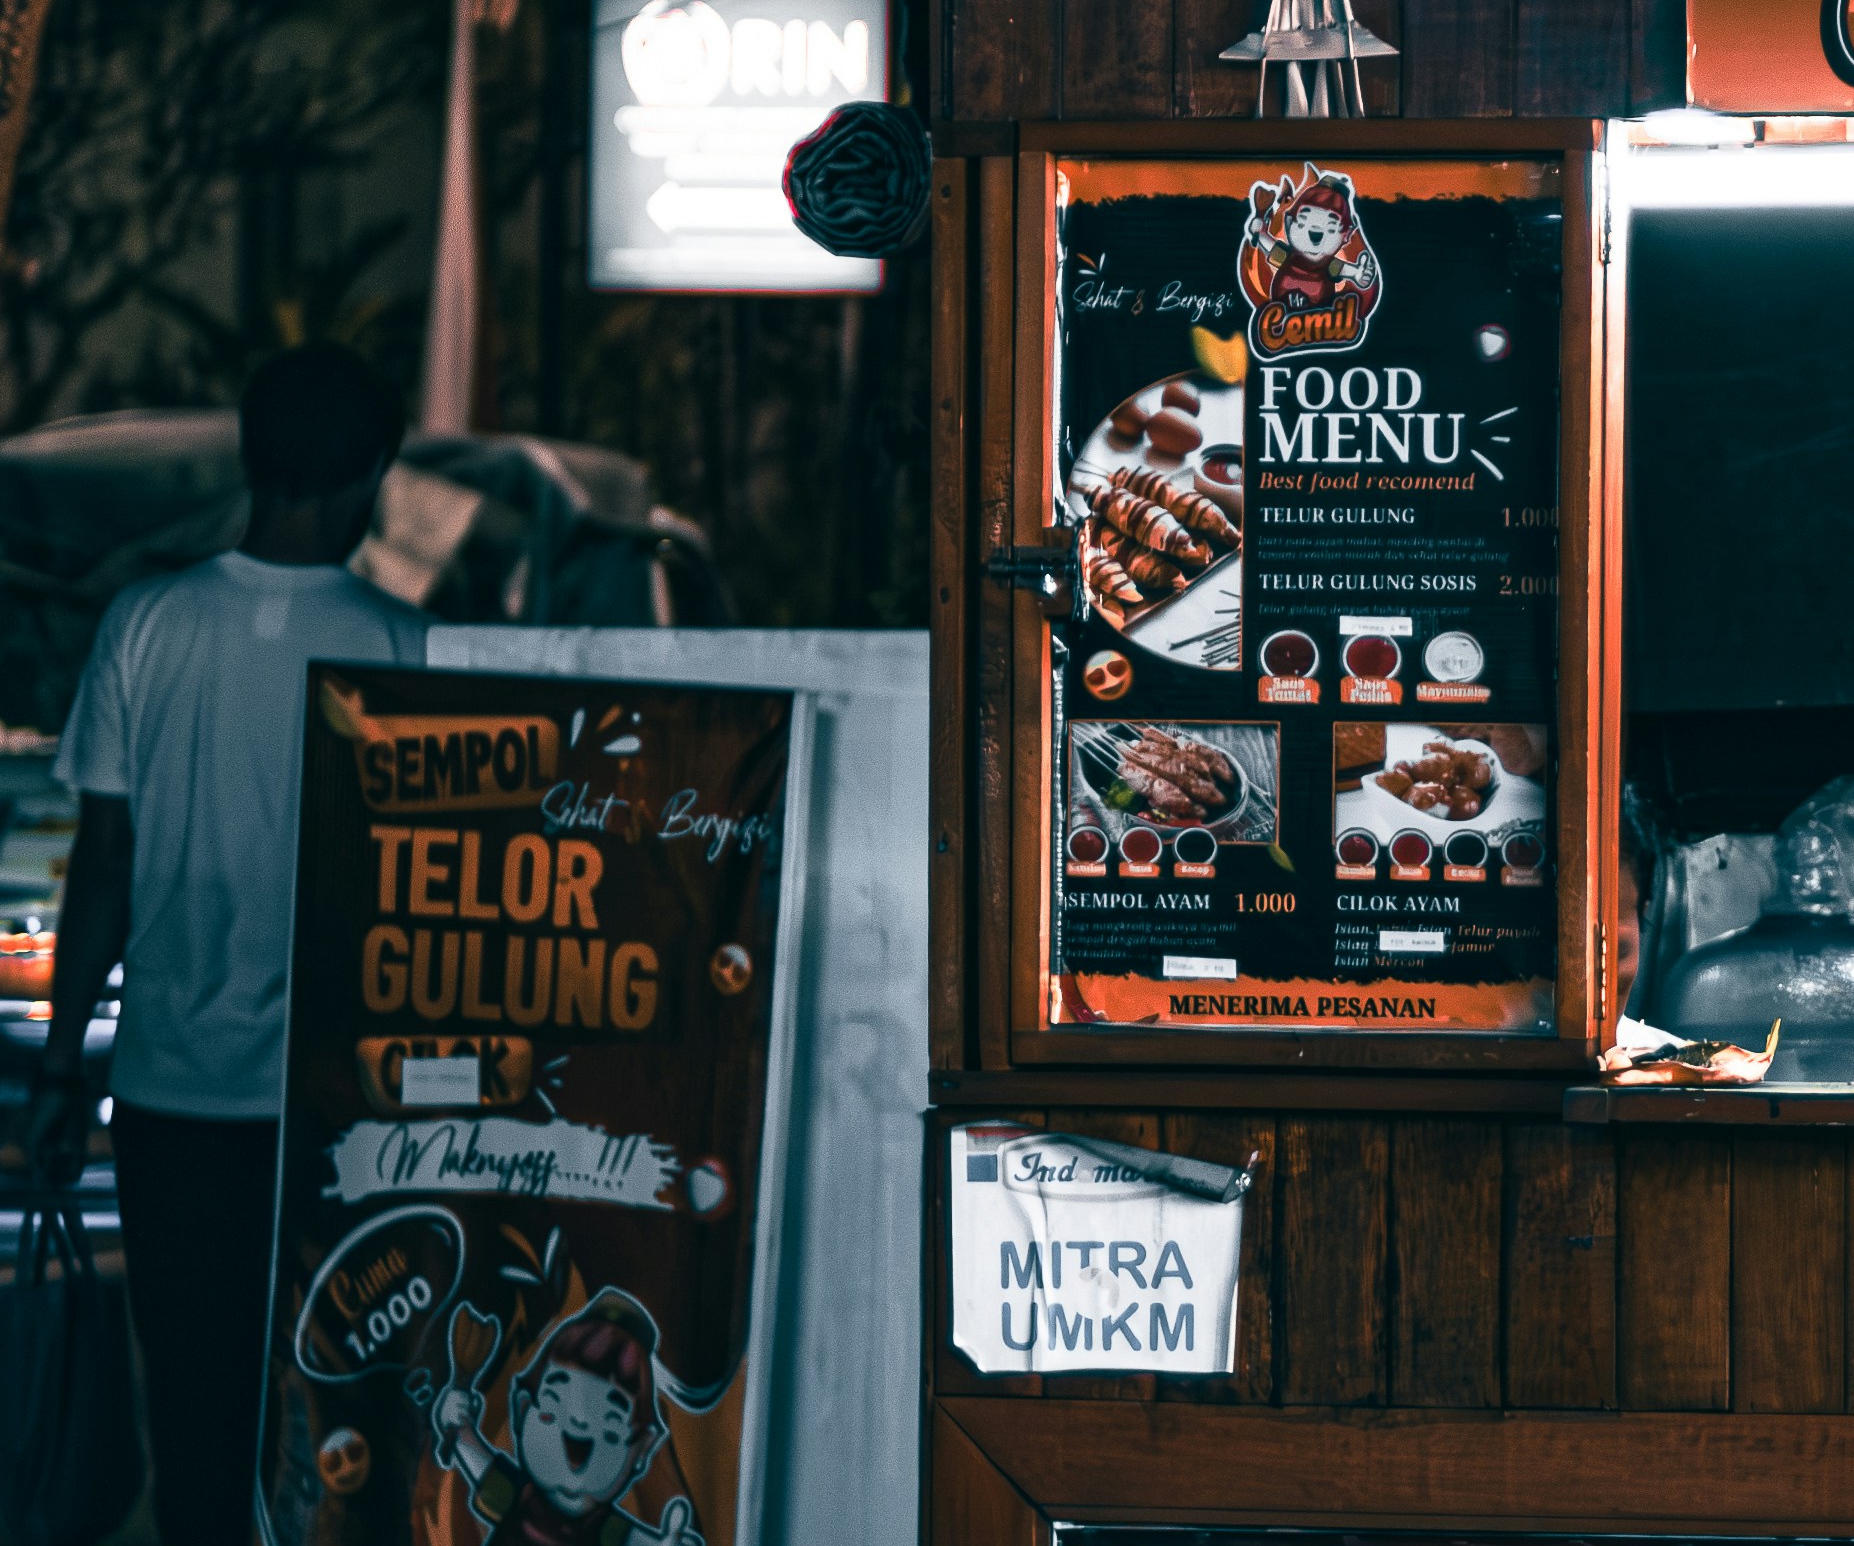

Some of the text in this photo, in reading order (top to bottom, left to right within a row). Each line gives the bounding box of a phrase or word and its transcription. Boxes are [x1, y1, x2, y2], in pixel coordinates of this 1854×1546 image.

[1072, 280, 1135, 312] Sehat
[1156, 280, 1234, 323] Bergizi
[1261, 297, 1357, 349] Cemil
[1258, 367, 1423, 411] FOOD
[1258, 412, 1466, 463] MENU
[1259, 472, 1477, 494] Best food recomend
[1259, 507, 1327, 525] TELUR
[1330, 507, 1416, 526] GULUNG
[1259, 573, 1325, 591] TELUR
[1329, 574, 1415, 591] GULUNG
[1419, 575, 1477, 592] SOSIS
[363, 724, 553, 804] SEMPOL
[369, 824, 603, 930] TELOR
[1067, 892, 1297, 913] SEMPOL AYAM 1.000
[1336, 895, 1461, 913] CILOK AYAM
[361, 924, 660, 1031] GULUNG
[1334, 954, 1369, 967] Isian
[1169, 995, 1437, 1019] MENERIMA PESANAN
[1000, 1240, 1194, 1290] MITRA
[345, 1275, 432, 1360] 1.000
[1001, 1301, 1195, 1352] UMKM
